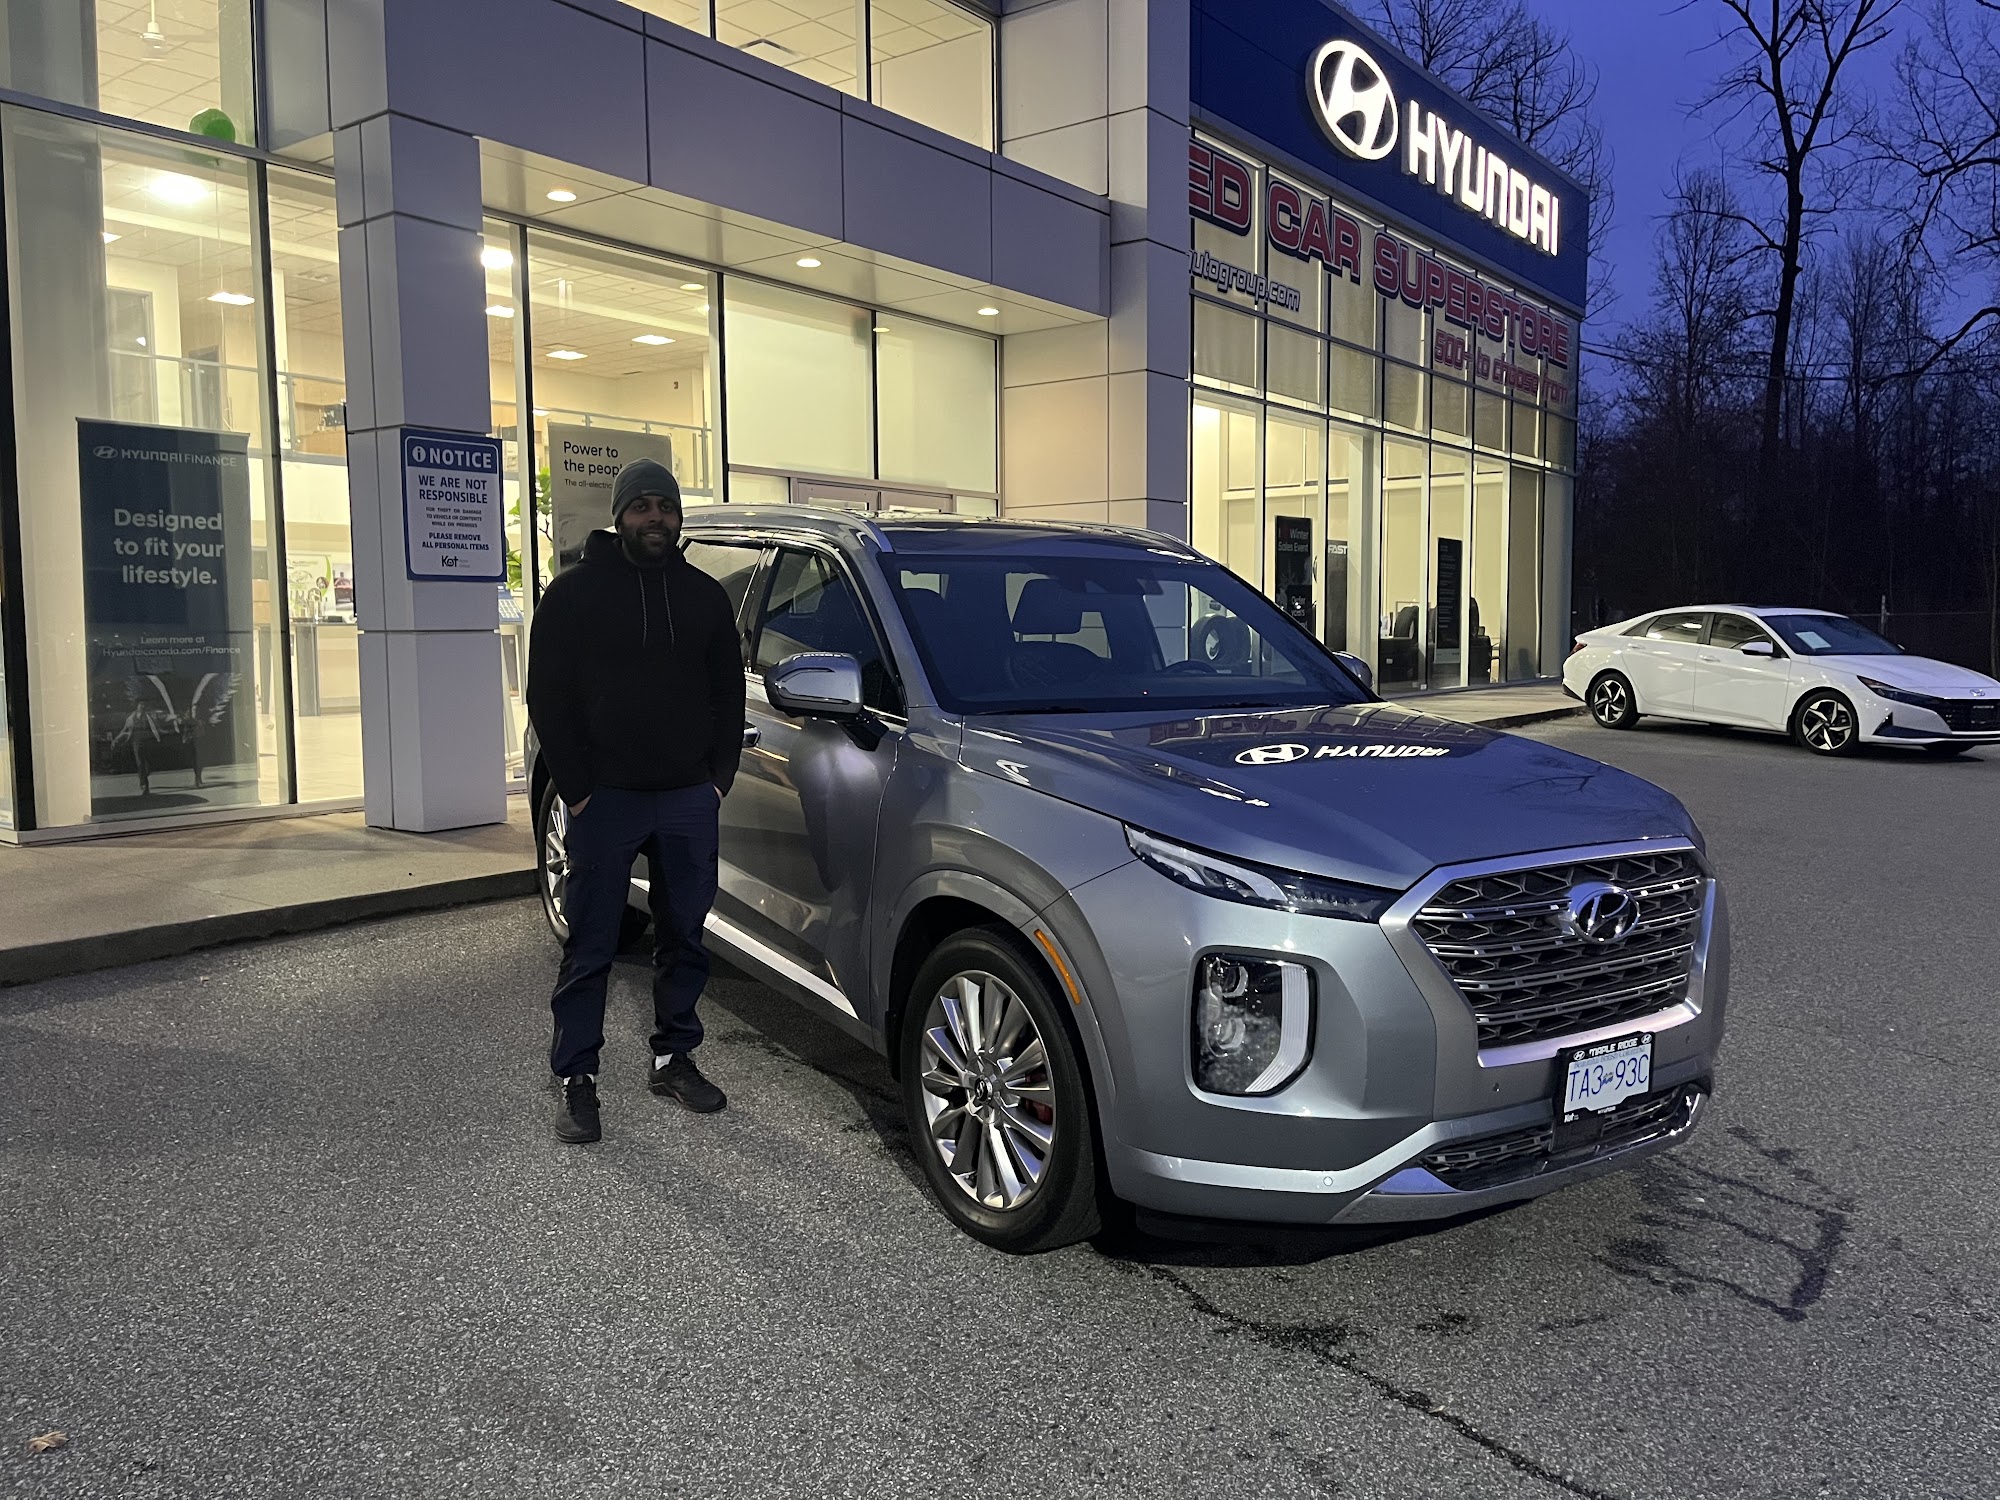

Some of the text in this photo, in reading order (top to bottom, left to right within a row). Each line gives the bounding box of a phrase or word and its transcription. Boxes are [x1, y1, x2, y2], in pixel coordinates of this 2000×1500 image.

[1409, 99, 1559, 257] HYUNDAI
[1268, 181, 1361, 285] CAR
[1374, 232, 1569, 369] SUPERSTORE
[1434, 329, 1569, 403] 500+ to choose from
[429, 447, 492, 468] NOTICE
[563, 441, 618, 458] Power to
[184, 453, 237, 467] FINANCE
[563, 459, 585, 473] the
[418, 474, 487, 490] WE ARE NOT
[565, 479, 577, 487] The
[419, 489, 488, 504] RESPONSIBLE
[114, 508, 222, 532] Designed
[429, 532, 481, 541] PLEASE REMOVE
[113, 537, 225, 560] to fit your
[422, 541, 489, 551] ALL PERSONAL ITEMS
[1277, 542, 1309, 553] Sales Event
[1327, 544, 1348, 555] FAST
[122, 564, 218, 588] lifestyle.
[140, 636, 168, 644] Learn
[1589, 1038, 1638, 1057] MAPLE RIDGE
[1569, 1065, 1603, 1102] TA3
[1615, 1054, 1649, 1090] 93C
